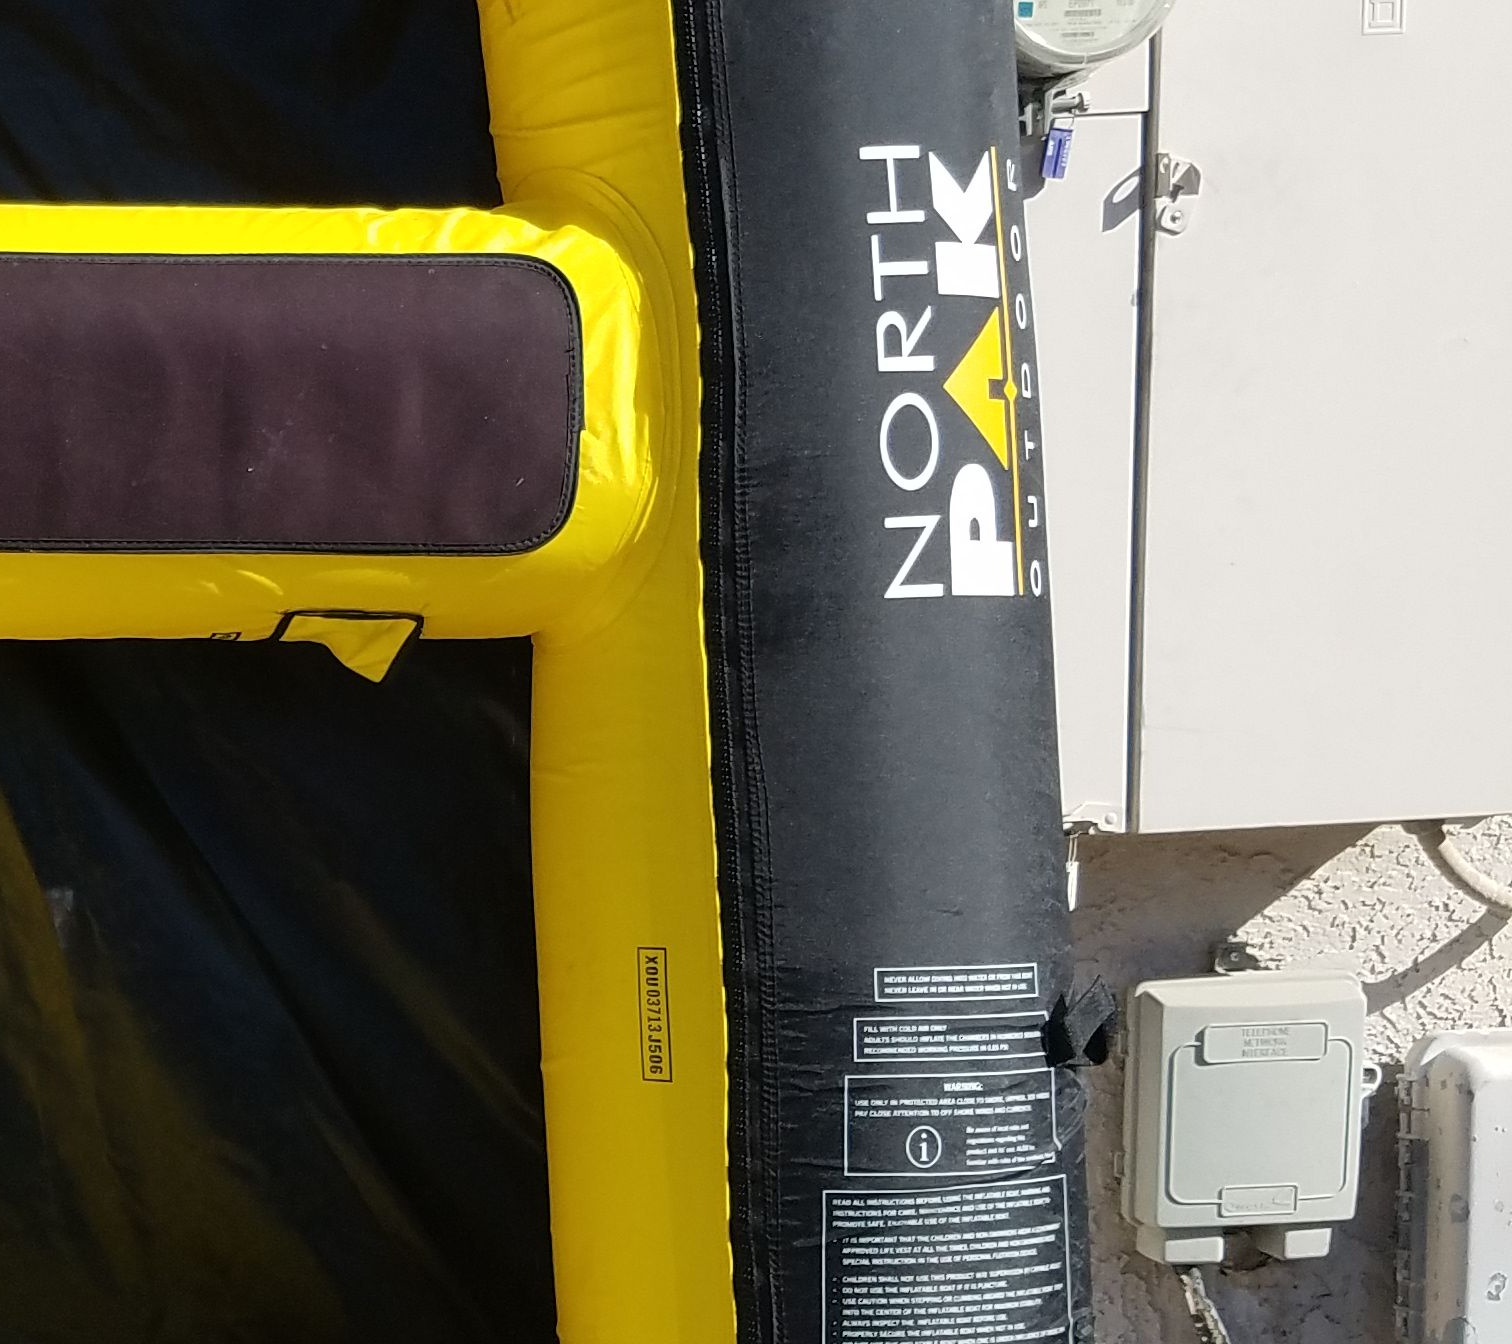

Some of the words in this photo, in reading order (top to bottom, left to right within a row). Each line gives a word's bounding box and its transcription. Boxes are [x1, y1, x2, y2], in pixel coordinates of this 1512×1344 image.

[859, 145, 944, 598] NORTH
[928, 150, 1015, 596] PAK
[1005, 158, 1042, 597] OUTDOOR
[646, 990, 662, 1033] 03713
[647, 1035, 663, 1074] J506
